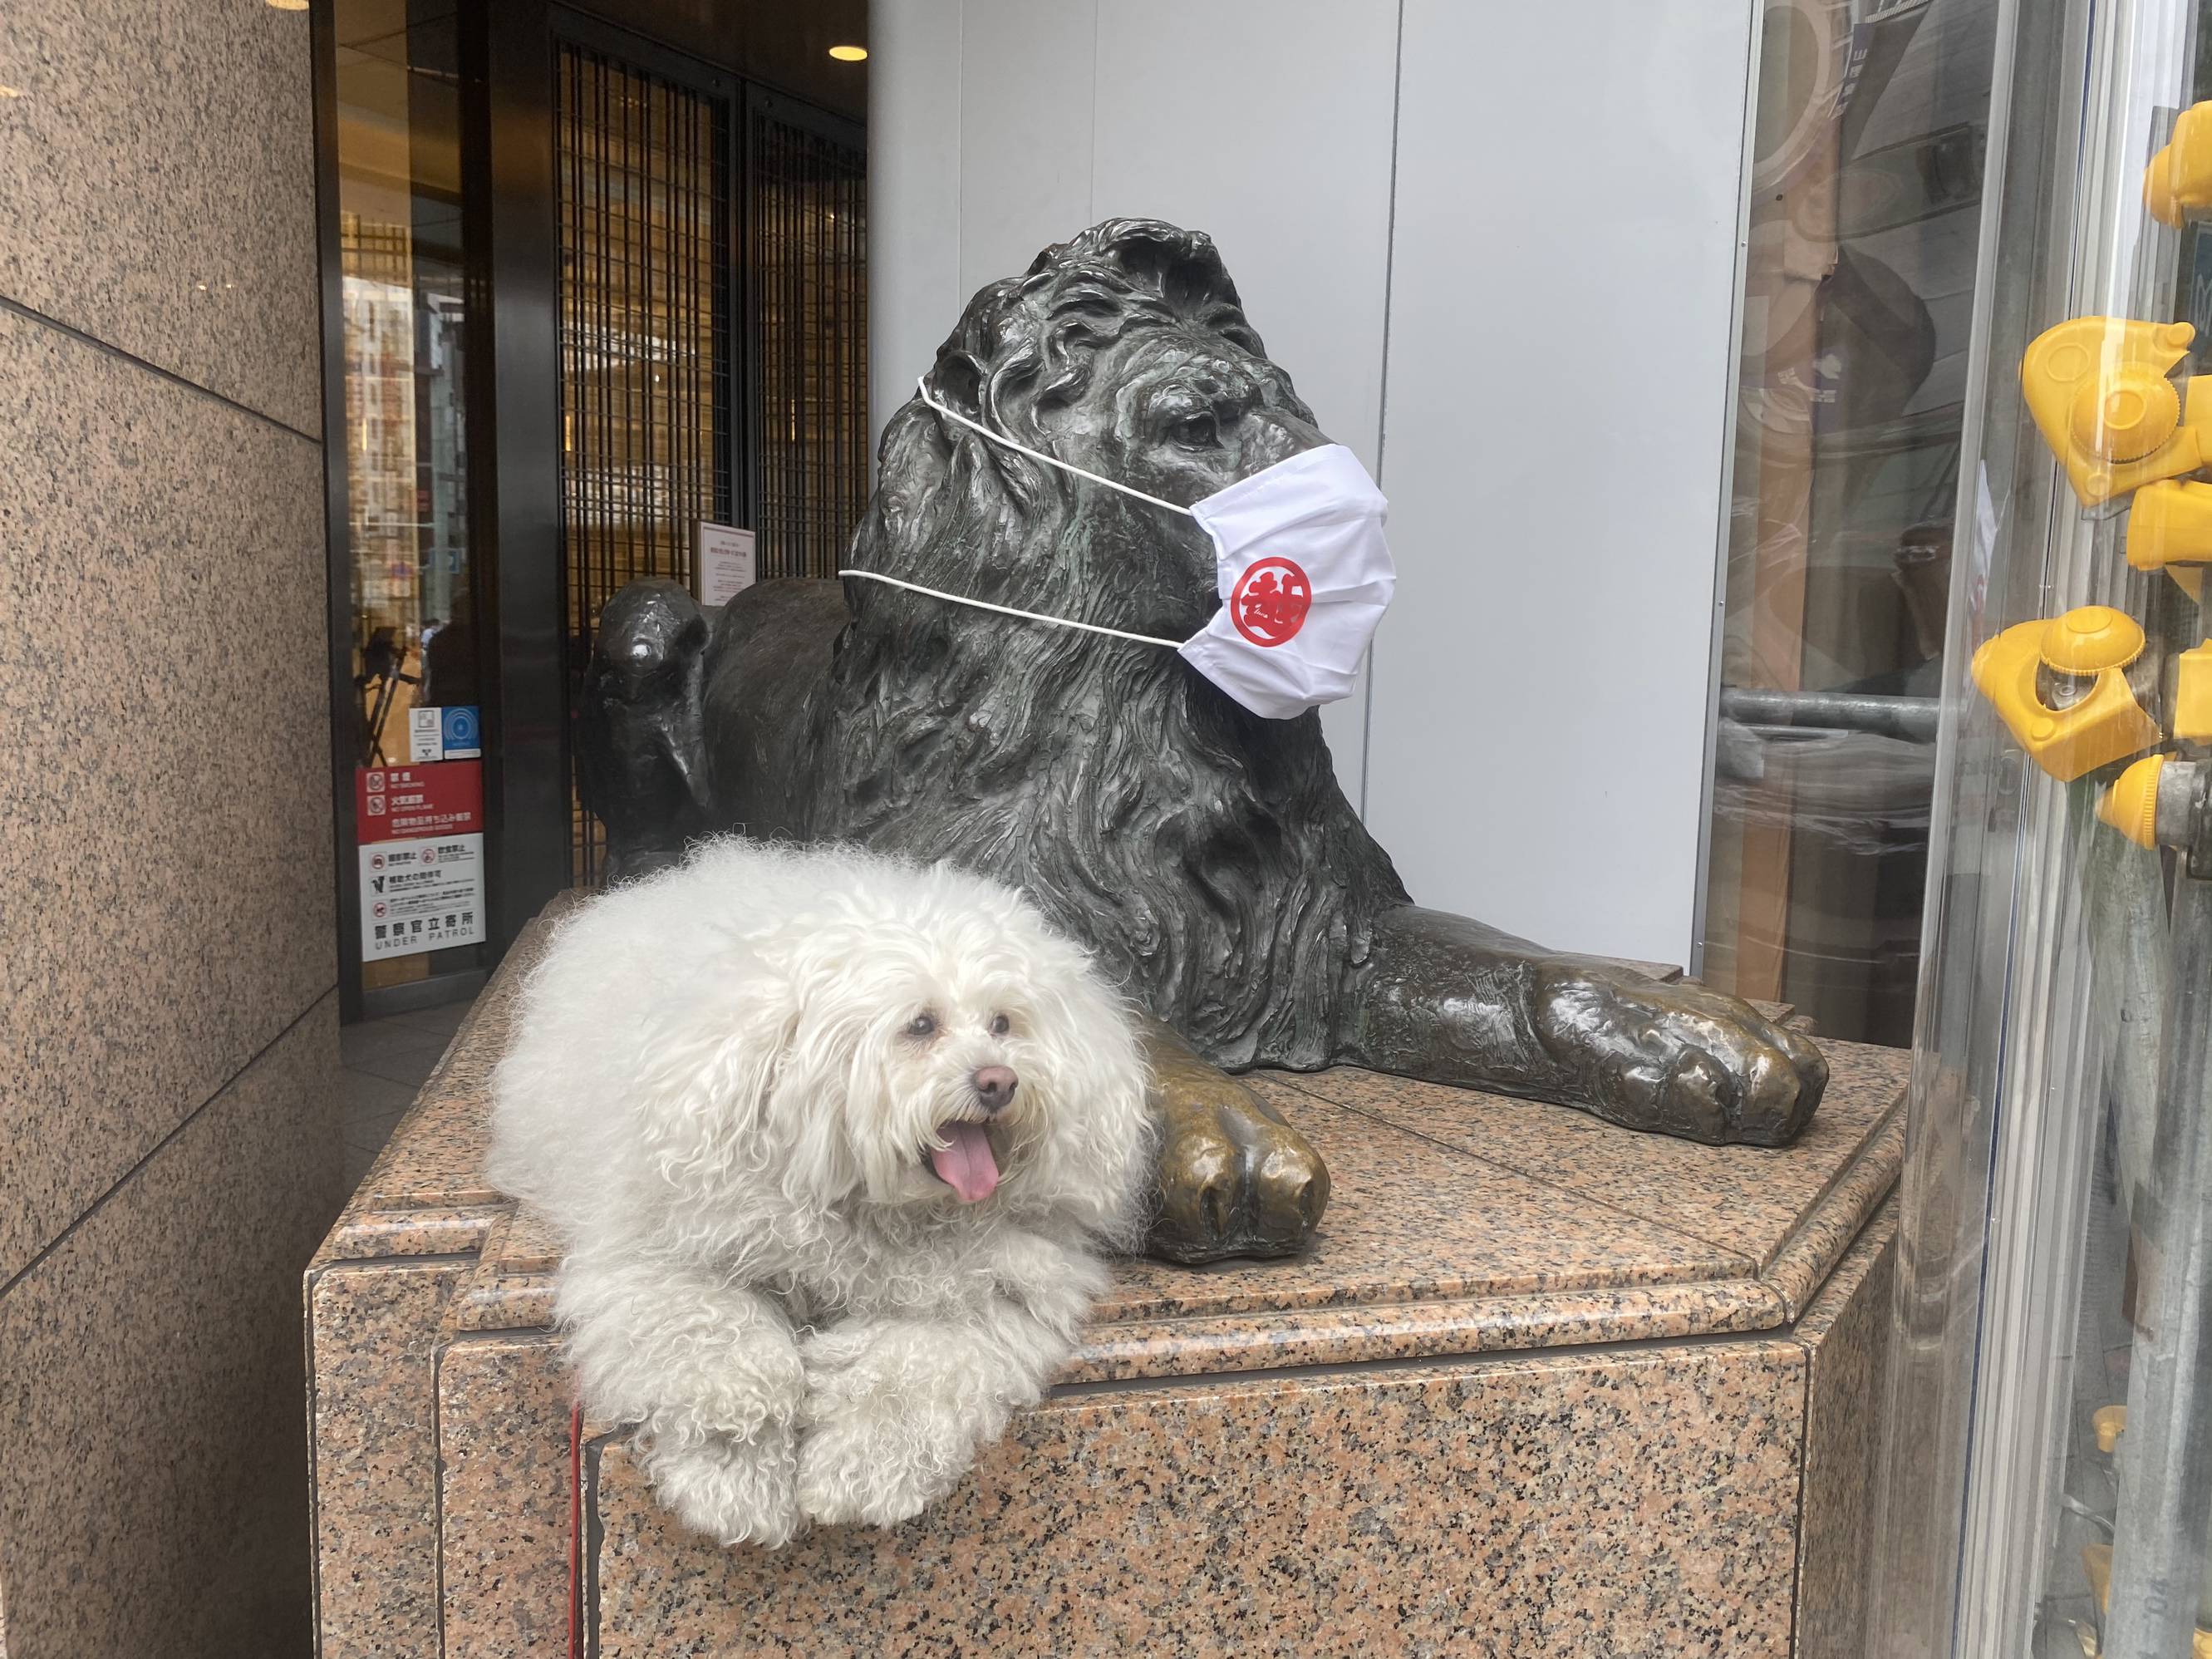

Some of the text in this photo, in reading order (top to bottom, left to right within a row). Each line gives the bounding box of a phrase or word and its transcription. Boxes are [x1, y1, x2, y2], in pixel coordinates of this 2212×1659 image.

[375, 911, 473, 939] 警察官立寄所
[376, 927, 474, 950] UNDER PATROL
